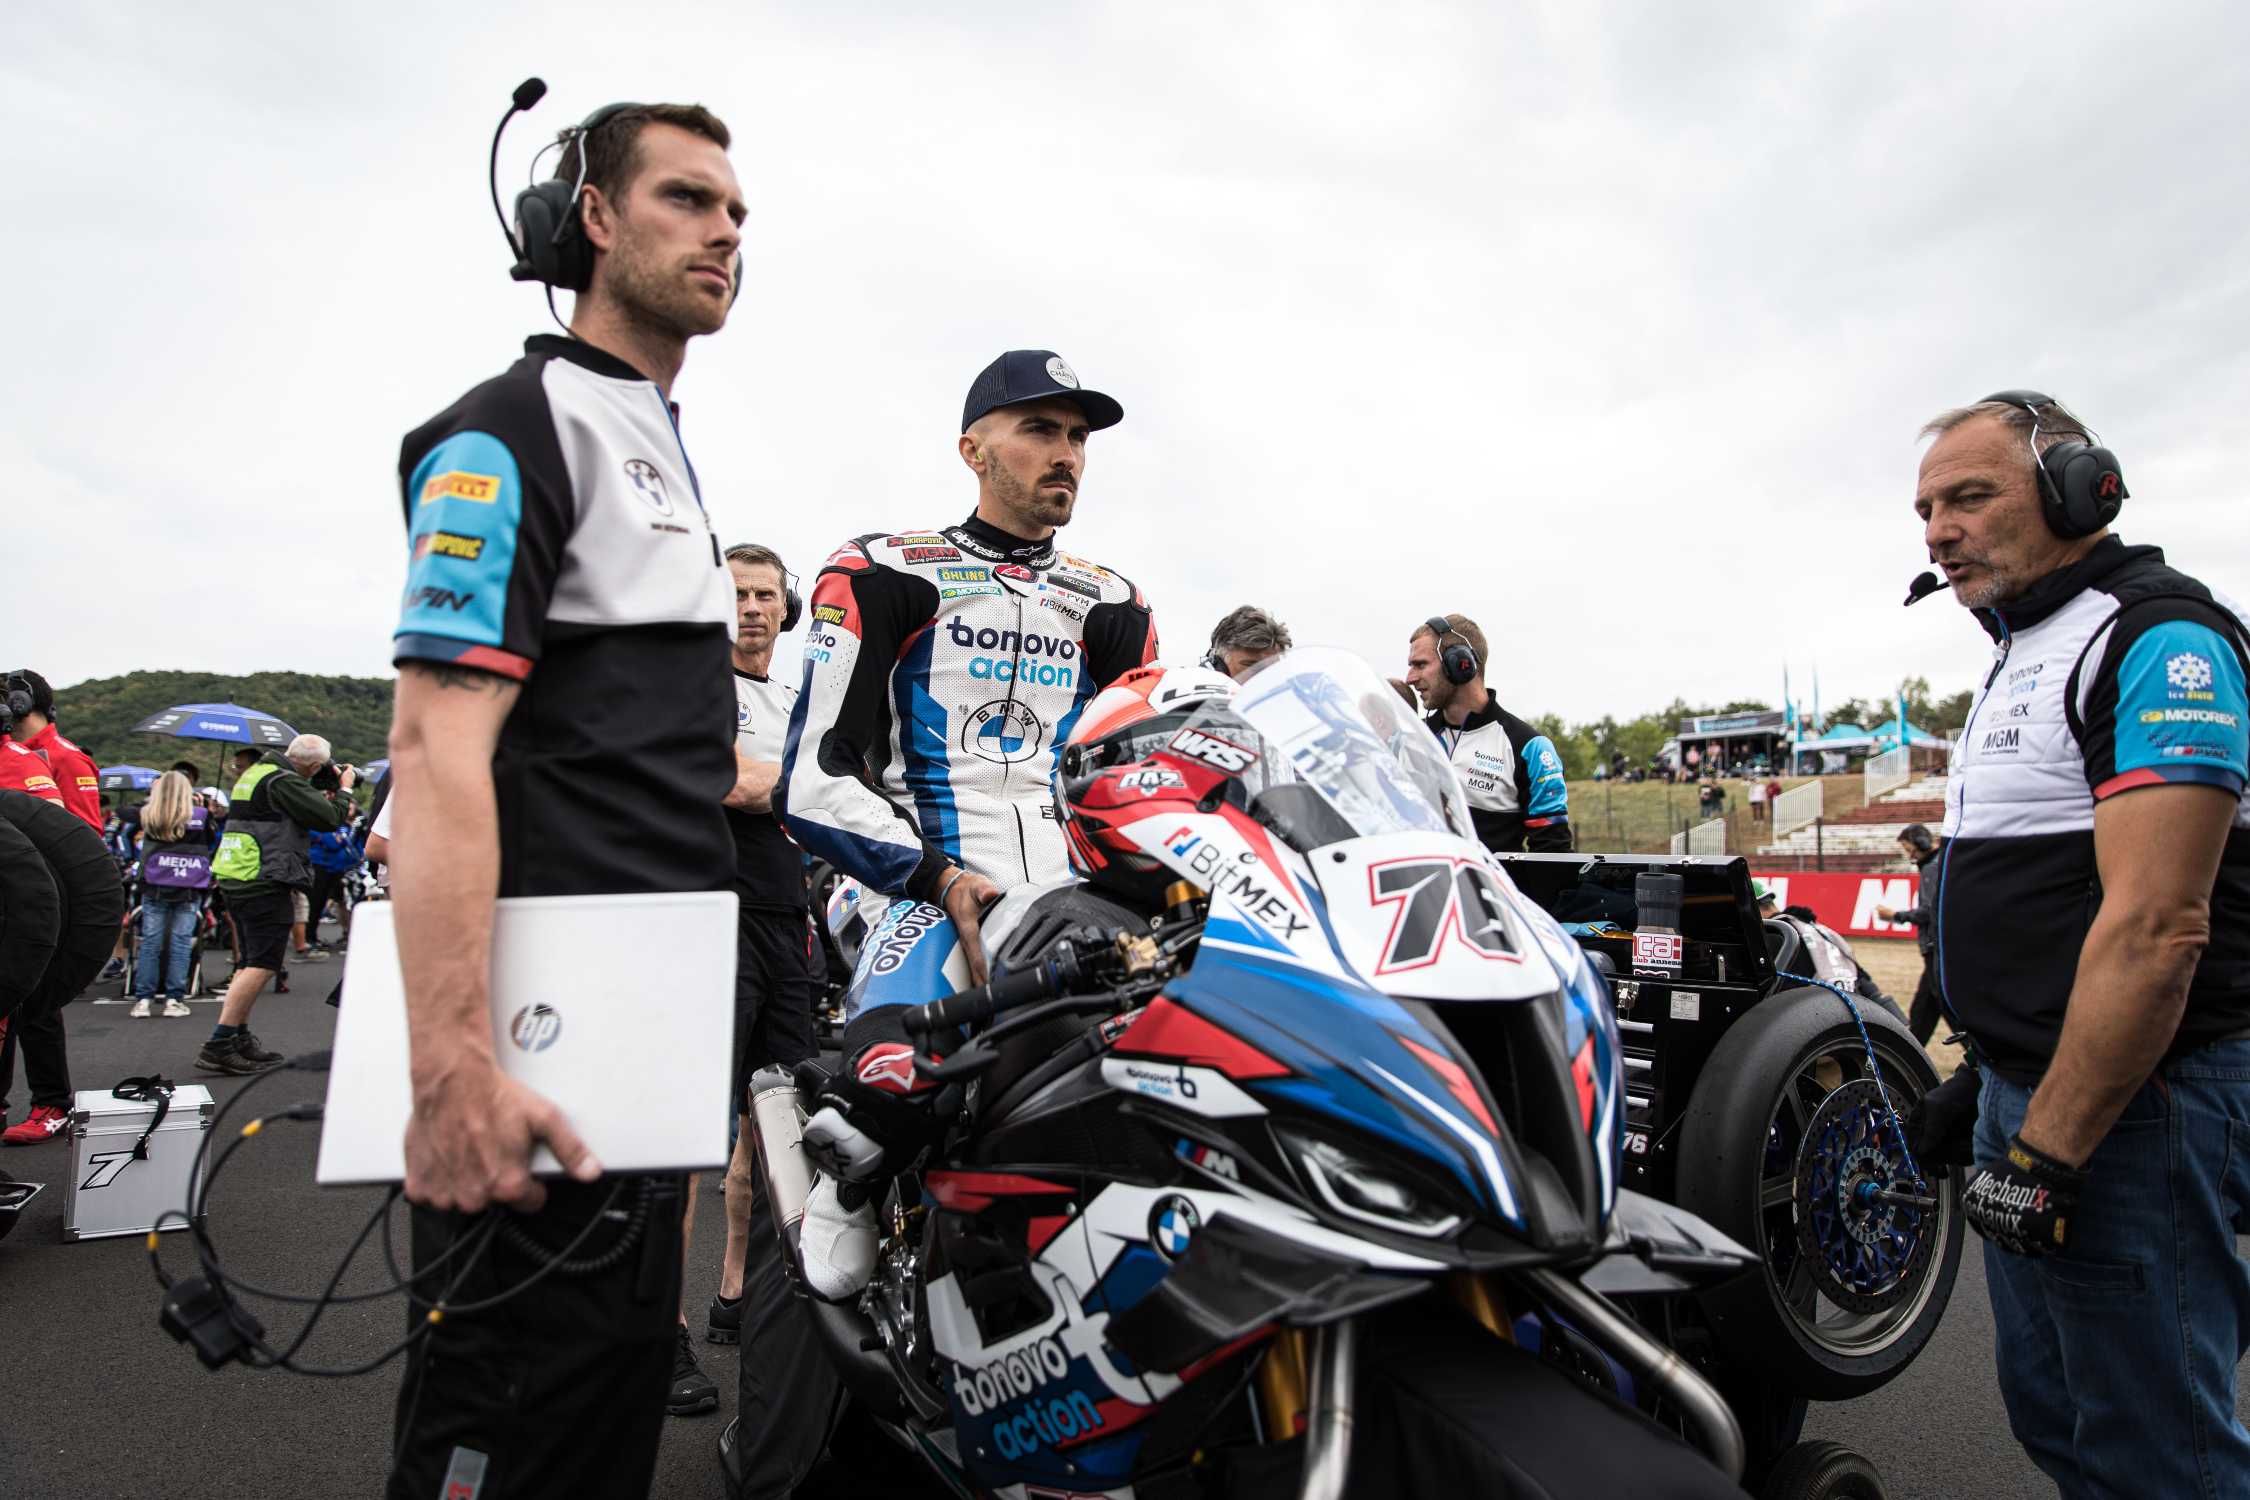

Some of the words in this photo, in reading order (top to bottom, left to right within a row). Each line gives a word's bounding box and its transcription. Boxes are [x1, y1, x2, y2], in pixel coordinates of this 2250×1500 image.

[1062, 575, 1099, 594] DELCOURT
[1049, 600, 1086, 624] BitMEX
[946, 615, 1077, 661] bonovo
[967, 656, 1074, 689] action
[2164, 709, 2238, 728] MOTOREX
[1175, 730, 1254, 772] WRS
[1982, 726, 2020, 750] MGM
[1468, 778, 1496, 793] MGM
[157, 855, 203, 869] MEDIA
[1190, 842, 1311, 941] BitMEX
[1967, 1170, 2050, 1213] Mechanix
[953, 1337, 1068, 1416] bonovo
[993, 1388, 1104, 1461] action
